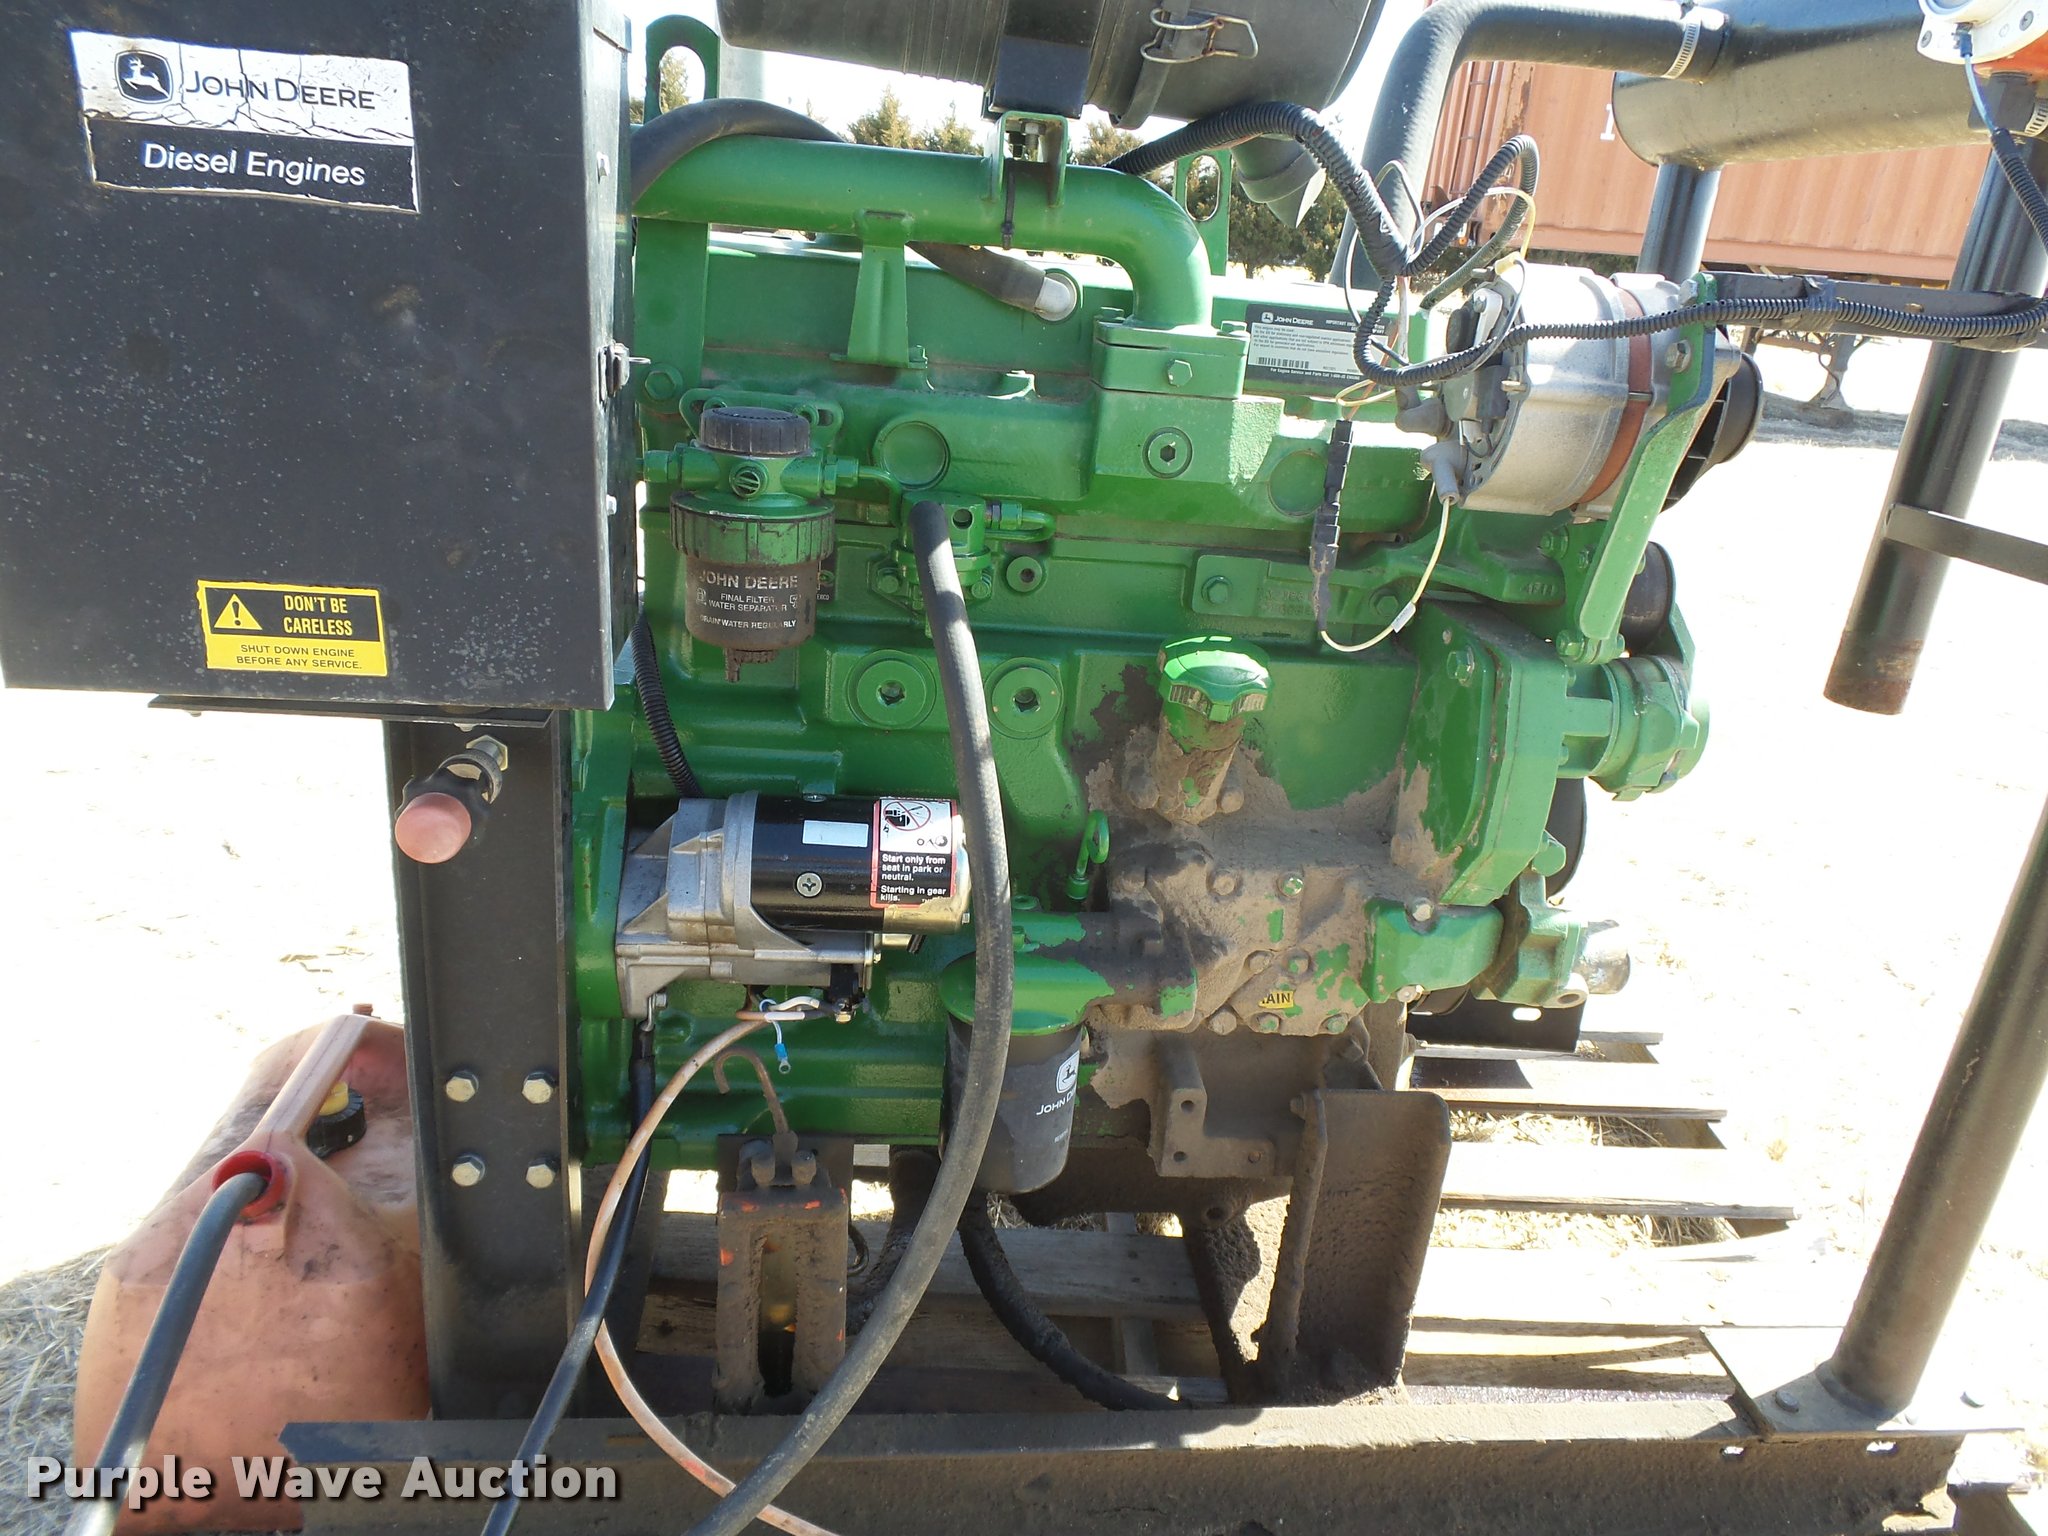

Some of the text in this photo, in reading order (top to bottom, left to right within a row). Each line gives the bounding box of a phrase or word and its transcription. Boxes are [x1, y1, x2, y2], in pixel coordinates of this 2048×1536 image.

[186, 71, 376, 110] JOHN DEERE
[144, 143, 365, 185] Diesel Engines
[1275, 316, 1292, 324] JOHN
[1293, 317, 1313, 326] DEERE
[699, 570, 798, 590] JOHN DEERE
[284, 595, 348, 613] DON'T BE
[720, 593, 775, 604] FINAL FILTER
[708, 599, 787, 612] WATER SEPARATR
[284, 617, 353, 636] CARELESS
[721, 619, 749, 628] WATER
[751, 619, 797, 629] REGRLY
[241, 644, 355, 657] SHUT DOWN ENGINE
[236, 656, 362, 669] BEFORE ANY SERVICE.
[882, 854, 946, 866] Start only from
[882, 863, 900, 872] seat
[902, 864, 911, 872] in
[912, 865, 932, 875] park
[881, 872, 914, 881] neutral.
[880, 885, 946, 896] Starting in gear
[1262, 993, 1291, 1004] AIN
[1036, 1097, 1066, 1116] JOHN
